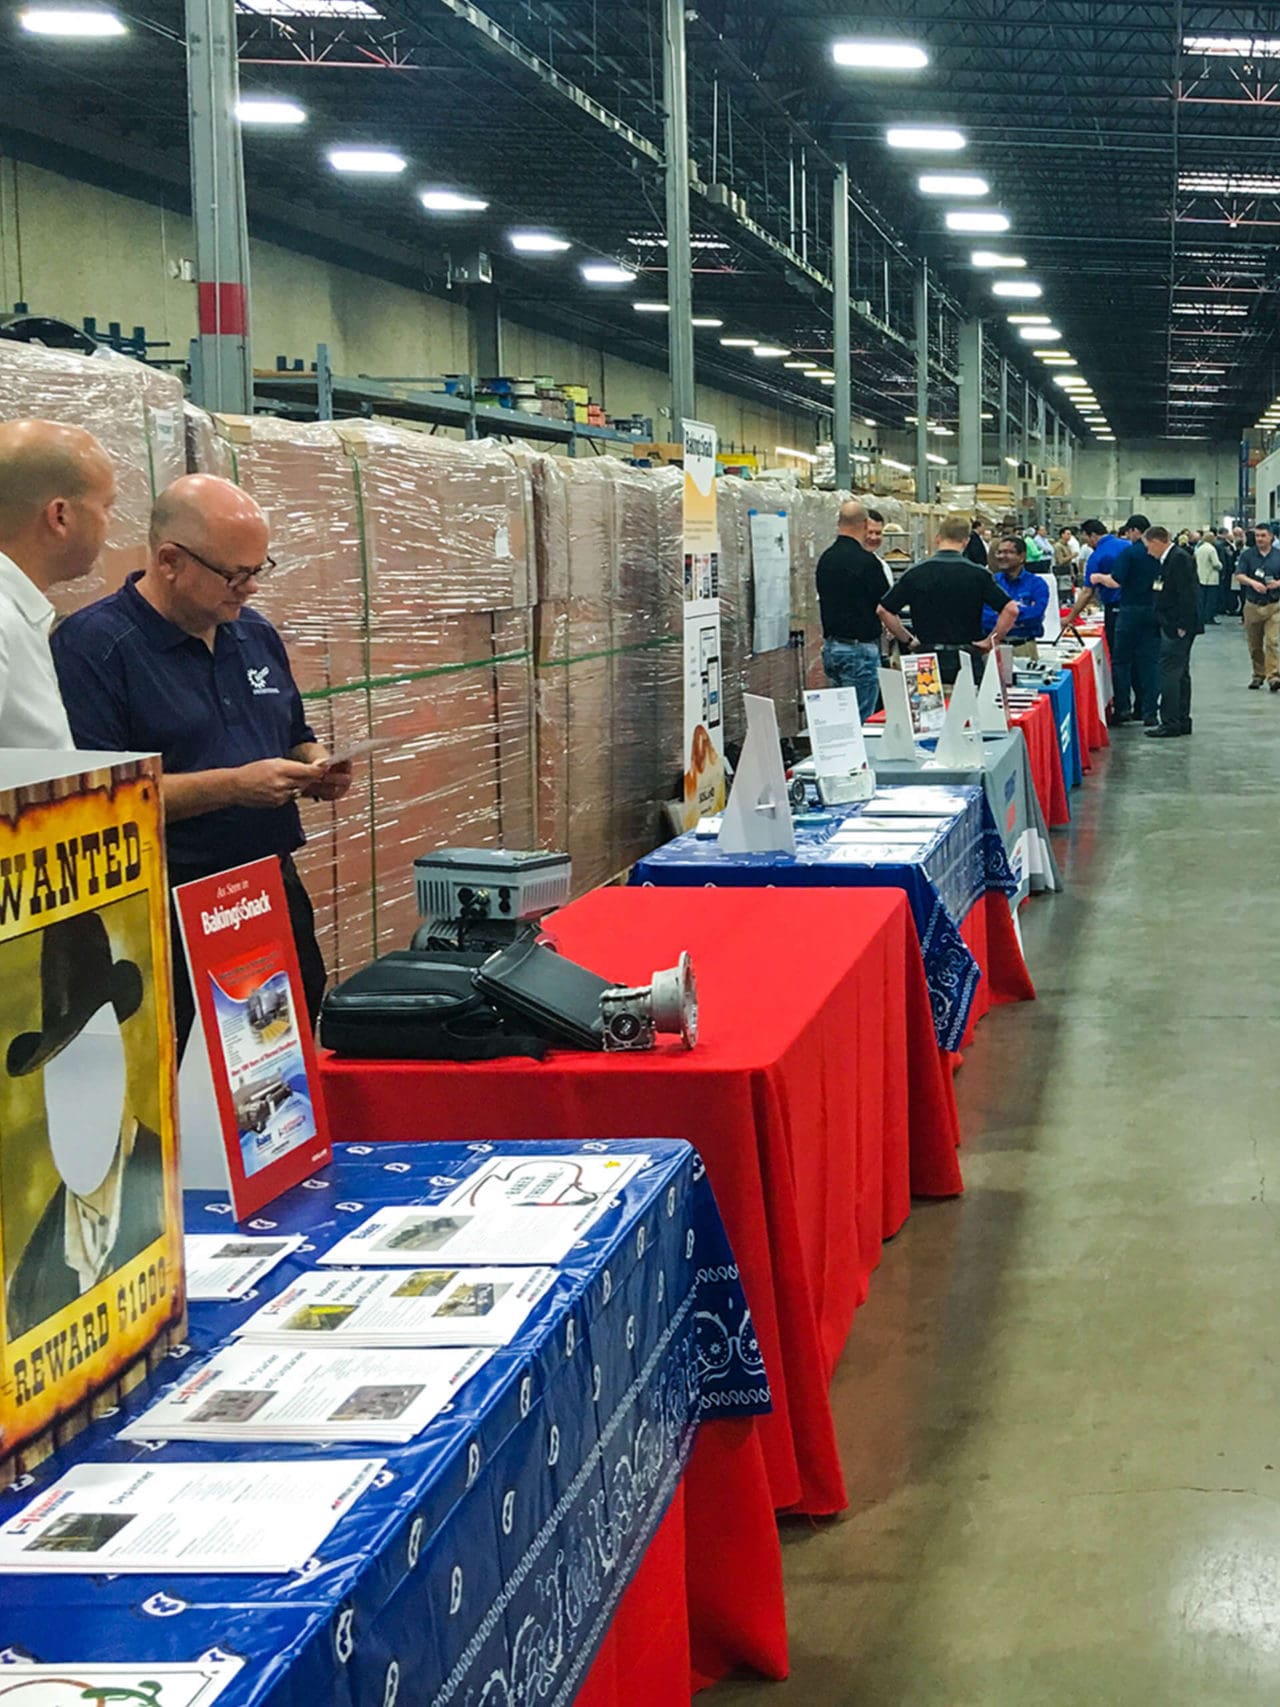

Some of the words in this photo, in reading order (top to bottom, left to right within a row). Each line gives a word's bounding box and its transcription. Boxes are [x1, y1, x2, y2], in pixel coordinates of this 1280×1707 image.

[0, 821, 141, 926] WANTED
[14, 1302, 109, 1408] REWARD
[117, 1257, 166, 1331] $1000
